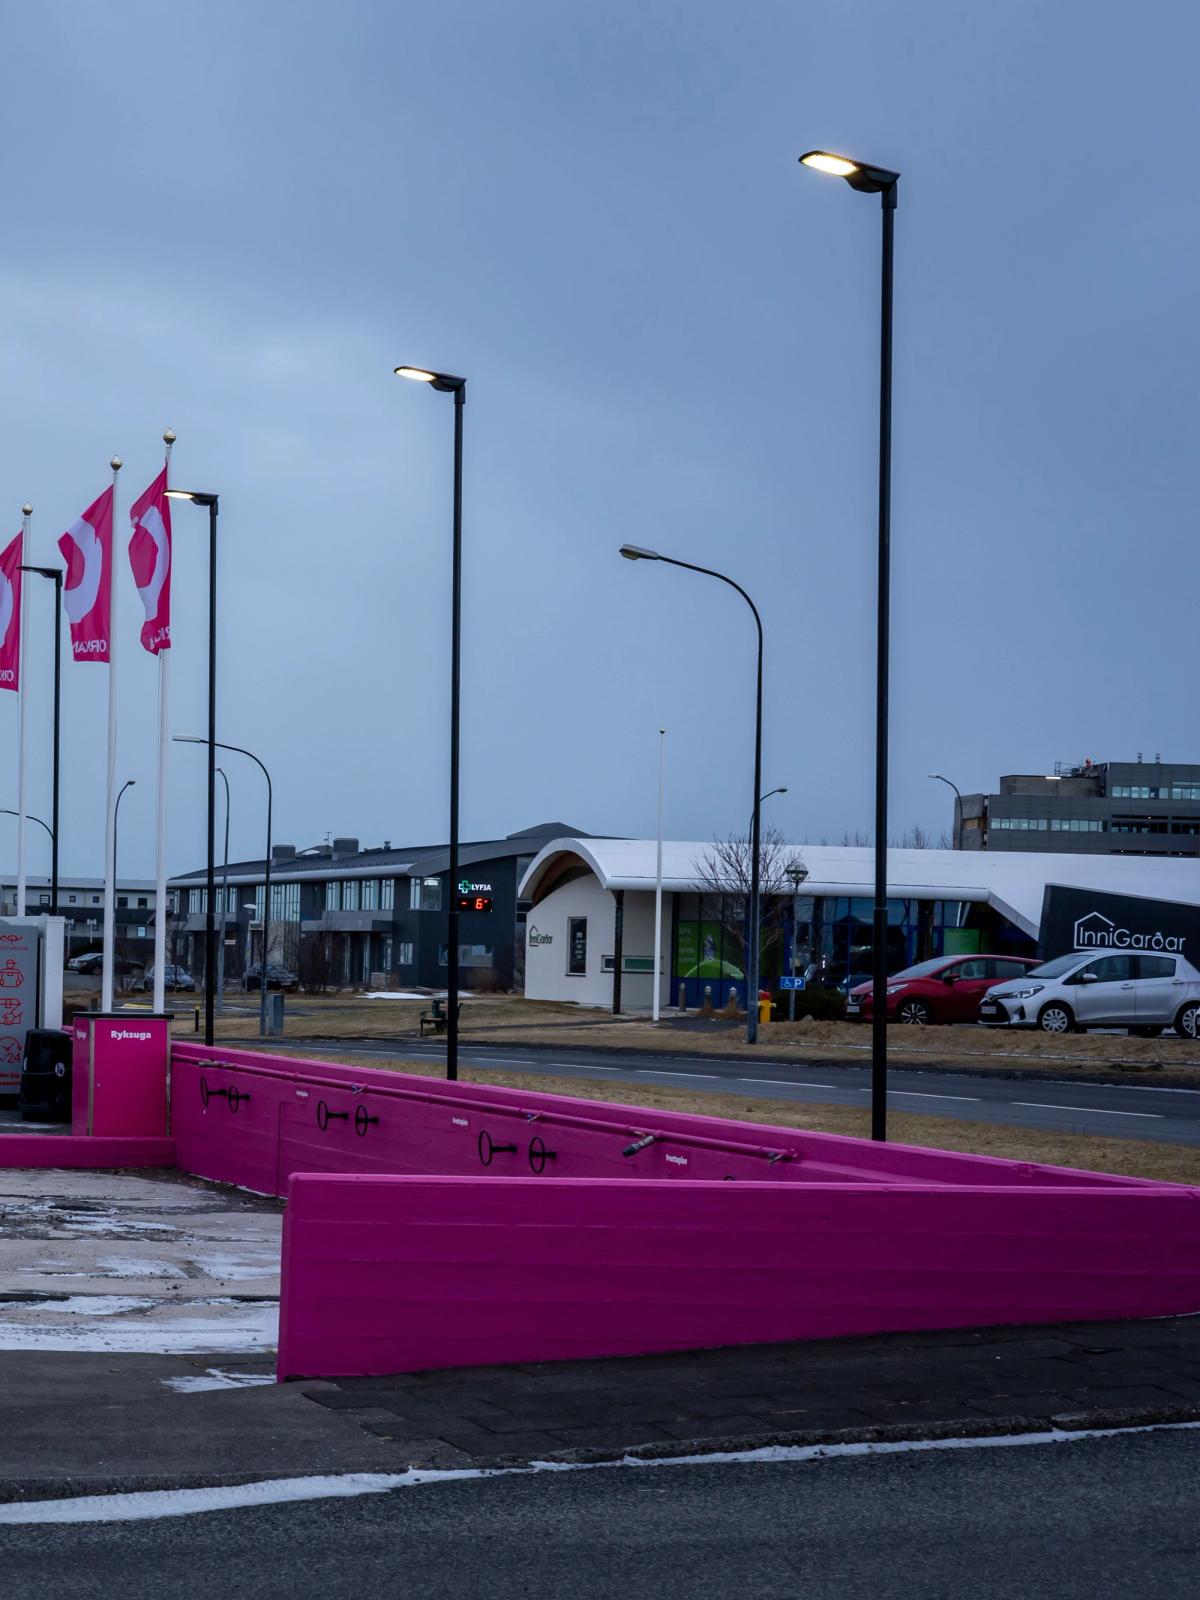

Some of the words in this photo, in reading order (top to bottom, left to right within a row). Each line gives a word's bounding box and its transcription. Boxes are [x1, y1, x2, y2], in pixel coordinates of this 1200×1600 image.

[471, 883, 492, 891] LYFJA
[1079, 926, 1187, 951] InniGarðar
[794, 979, 802, 988] P
[110, 1030, 152, 1041] Ryksuga
[6, 1052, 21, 1064] 24
